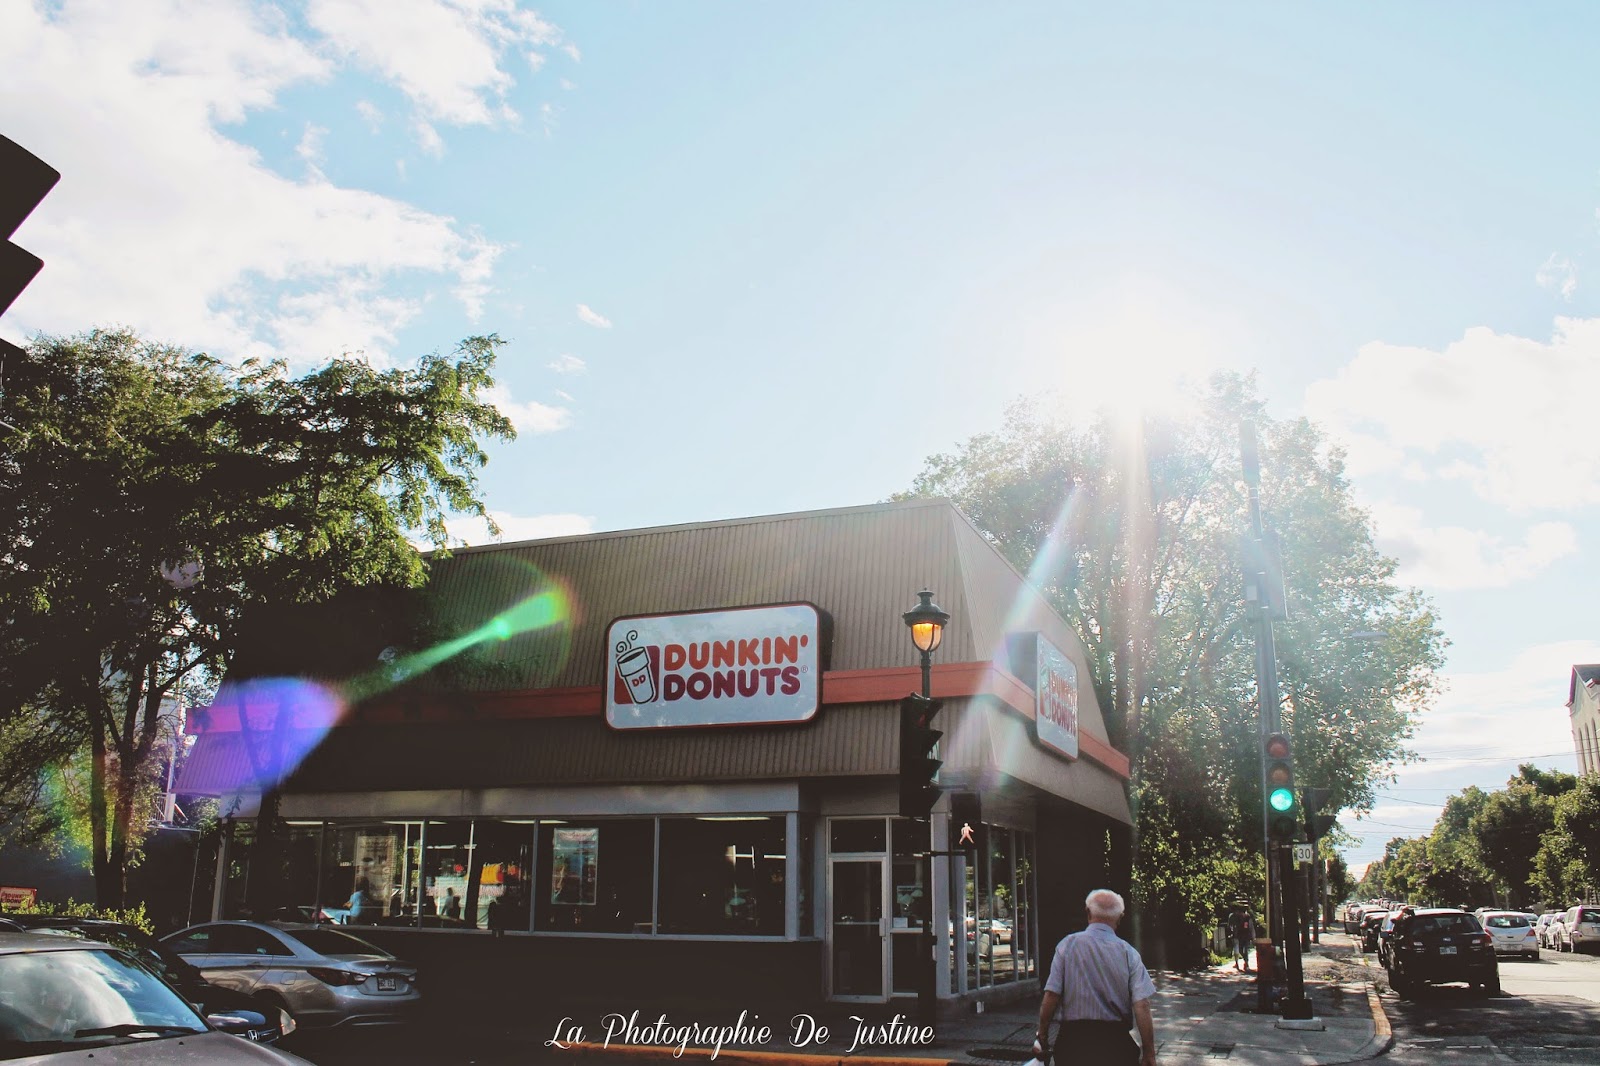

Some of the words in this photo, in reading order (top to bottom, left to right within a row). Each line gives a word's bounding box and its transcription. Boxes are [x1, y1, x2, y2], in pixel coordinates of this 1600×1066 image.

[664, 634, 809, 671] DUNKIN'
[632, 674, 647, 688] DD
[663, 666, 801, 701] DONUTS
[1298, 848, 1311, 859] 30
